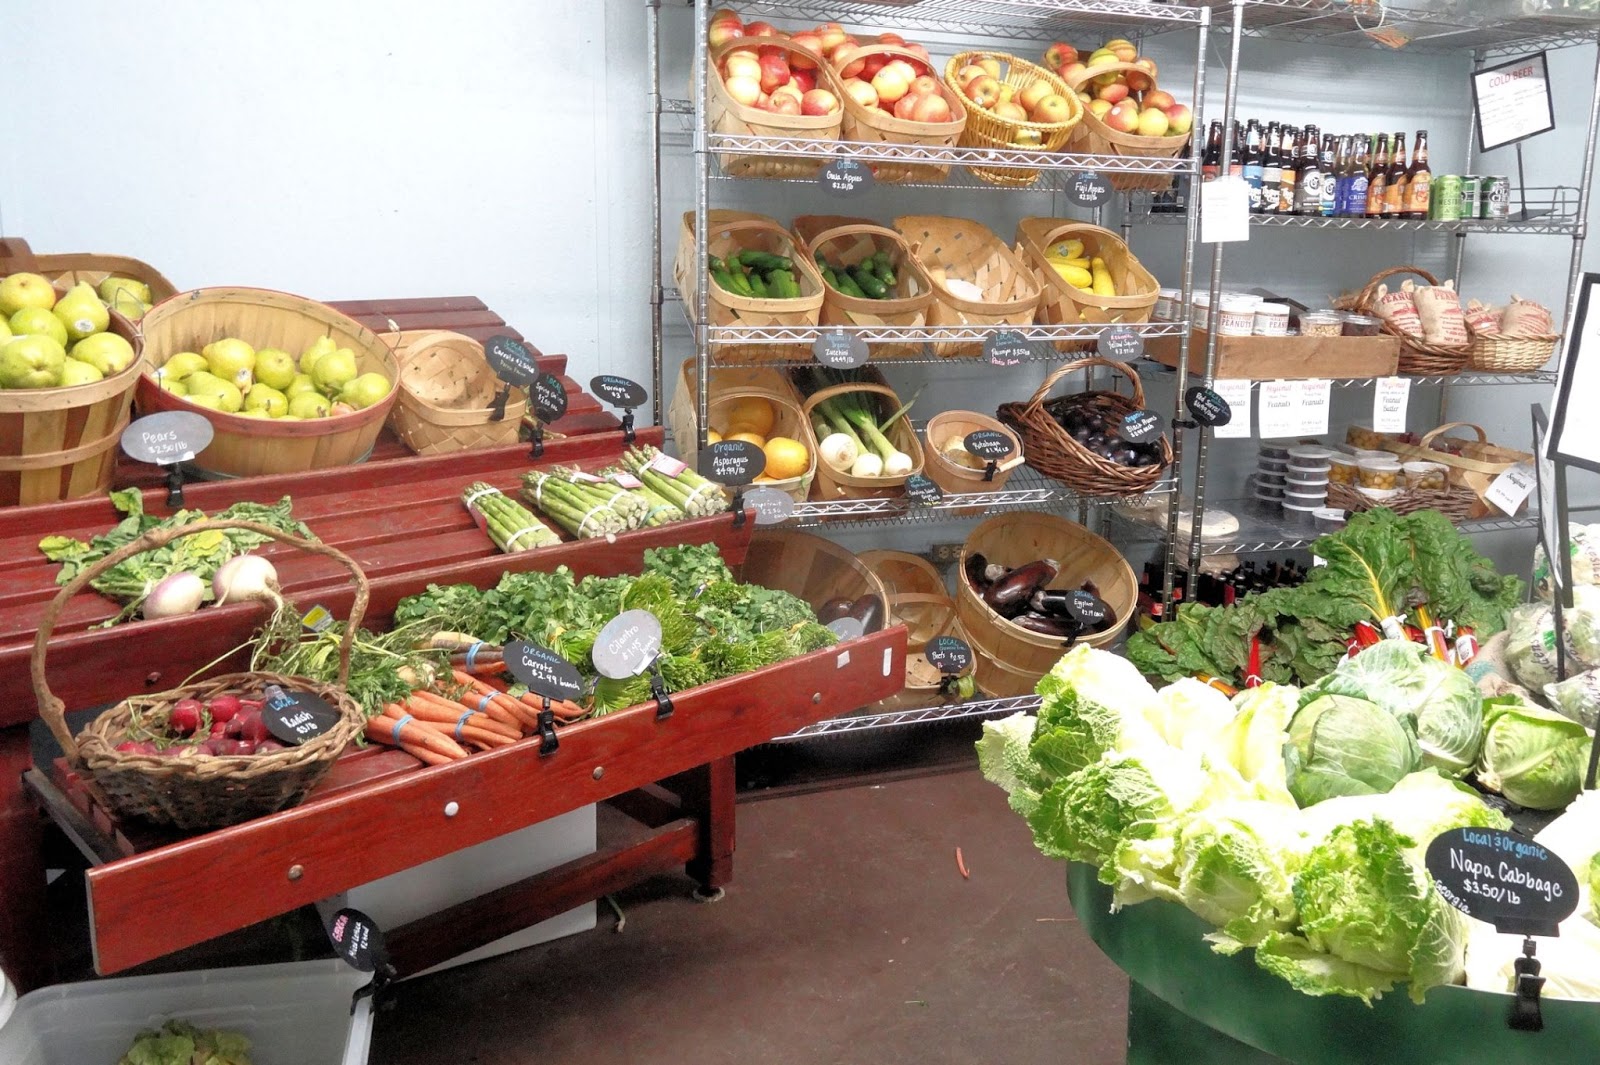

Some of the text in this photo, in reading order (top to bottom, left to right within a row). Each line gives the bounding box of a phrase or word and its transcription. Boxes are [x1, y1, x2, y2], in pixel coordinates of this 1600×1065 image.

[1489, 66, 1534, 88] COLD BEER
[843, 173, 863, 183] Apples
[1075, 182, 1088, 193] Fuji
[535, 381, 550, 398] Spring
[1125, 422, 1143, 433] Black
[142, 430, 177, 444] Pears
[714, 443, 745, 456] Organic
[713, 456, 749, 469] Asparagus
[1074, 598, 1094, 609] Eggplant
[608, 625, 639, 655] Cilantro
[522, 645, 561, 664] ORGANIC
[931, 651, 946, 660] Beets
[522, 655, 553, 674] Carrots
[532, 669, 580, 691] $2.99 bunch
[280, 711, 314, 728] Radish
[1462, 828, 1492, 847] Local
[1503, 836, 1548, 861] Organic
[1450, 848, 1563, 901] Napa Cabbage
[1434, 879, 1471, 914] Georgia
[1463, 878, 1521, 905] $3.50/lb
